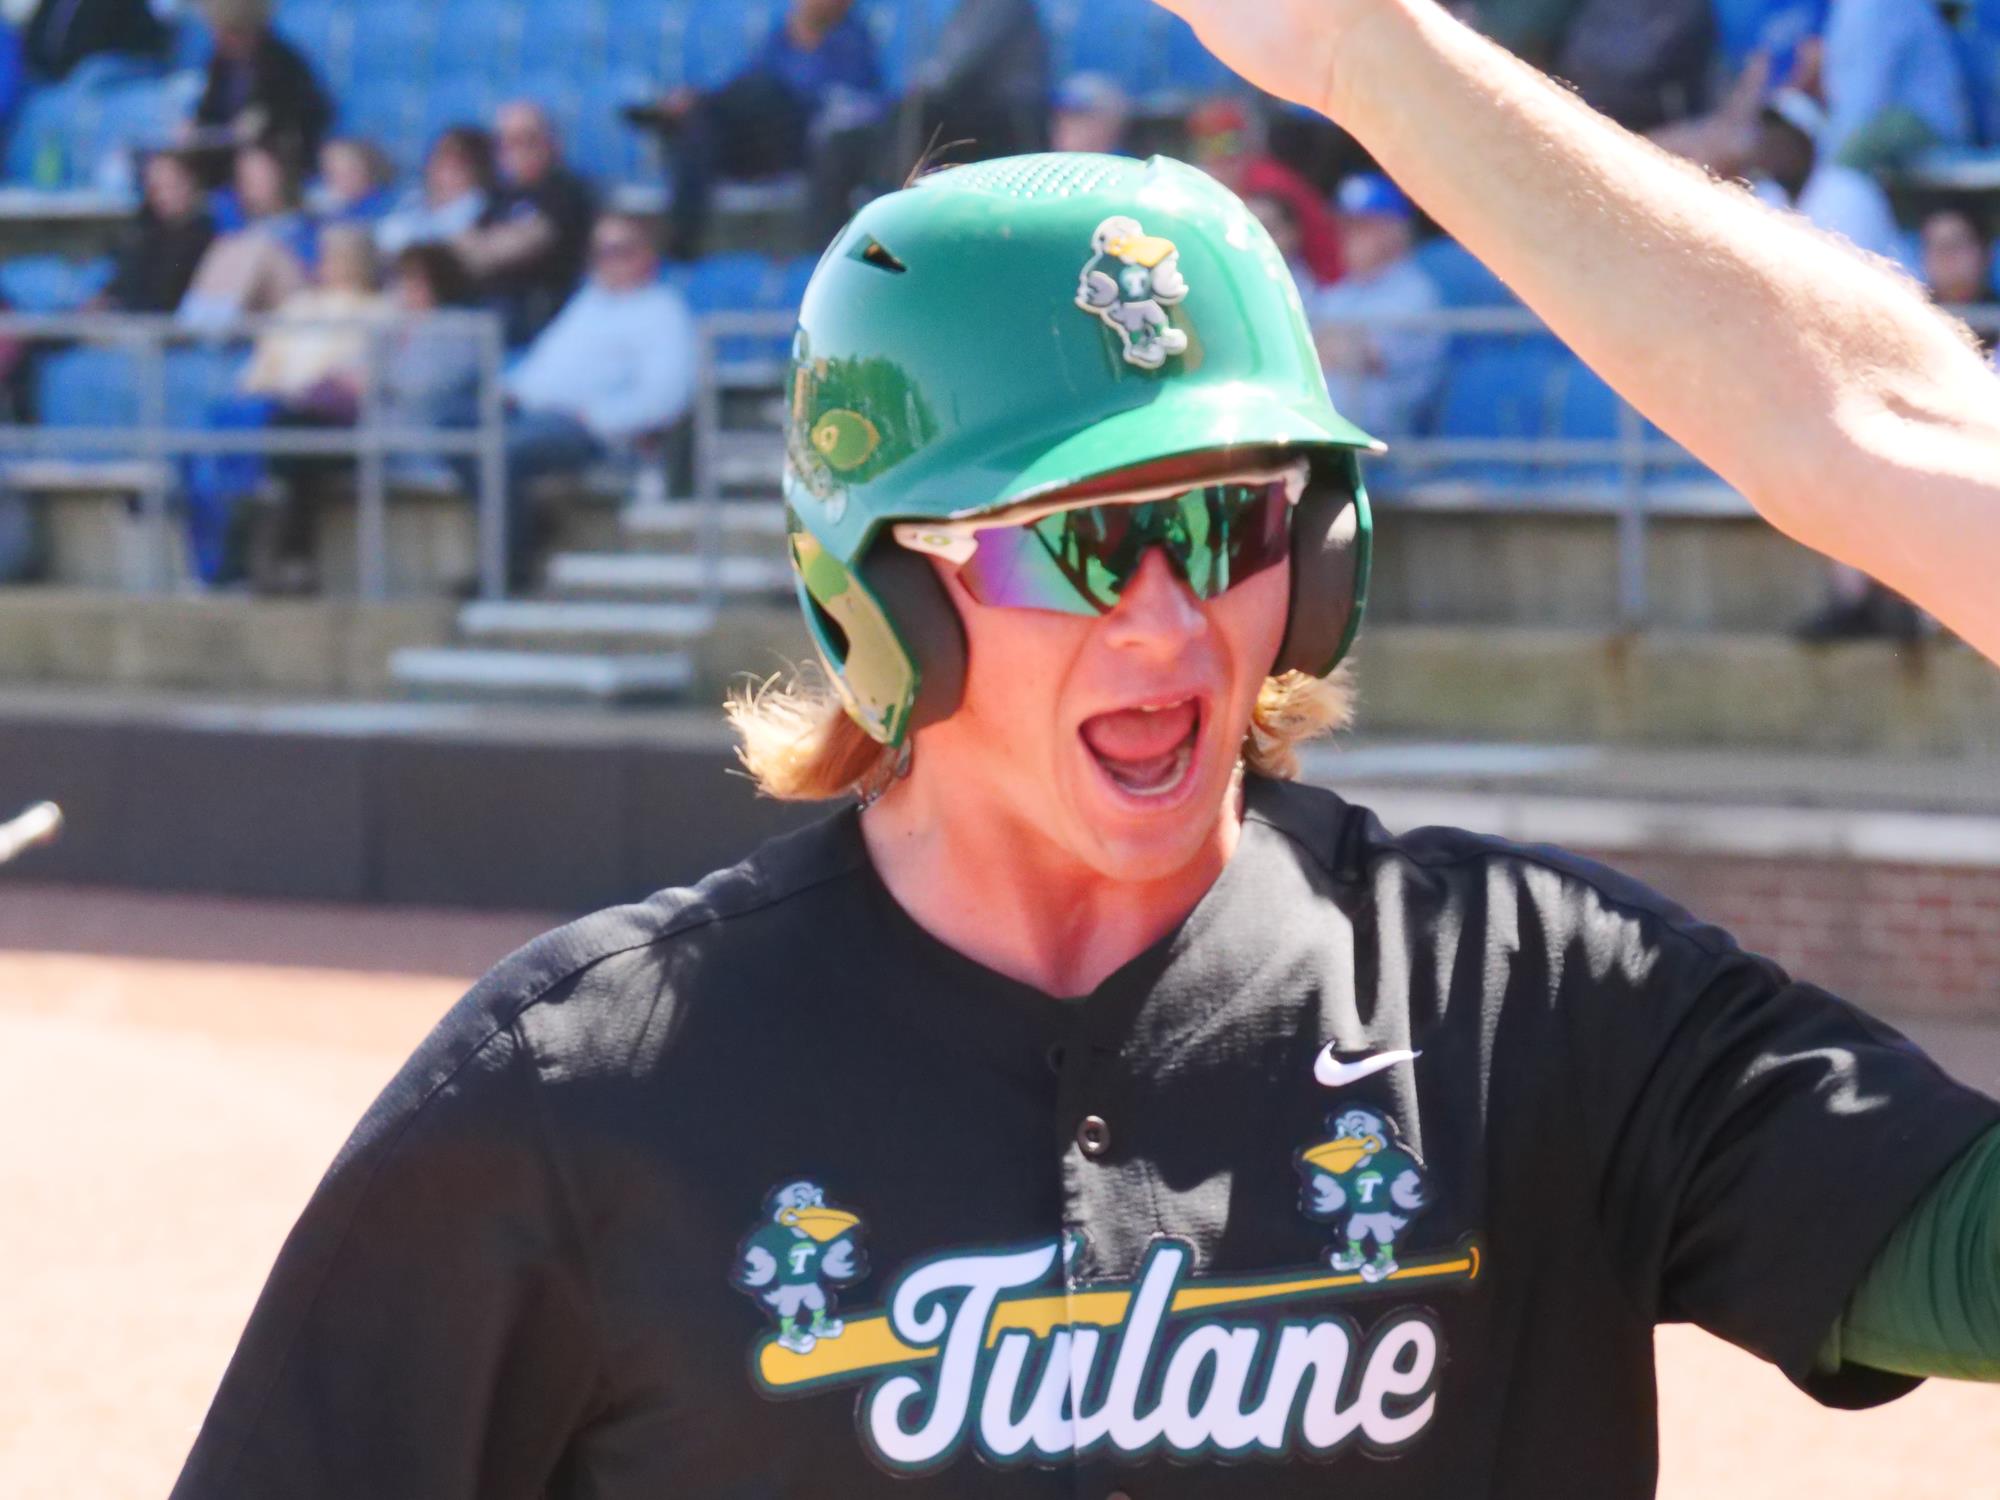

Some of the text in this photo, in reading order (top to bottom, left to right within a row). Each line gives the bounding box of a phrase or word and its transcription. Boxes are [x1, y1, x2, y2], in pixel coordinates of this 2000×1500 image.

[1356, 1176, 1384, 1204] T
[788, 1246, 818, 1275] T
[869, 1239, 1438, 1463] Tulane
